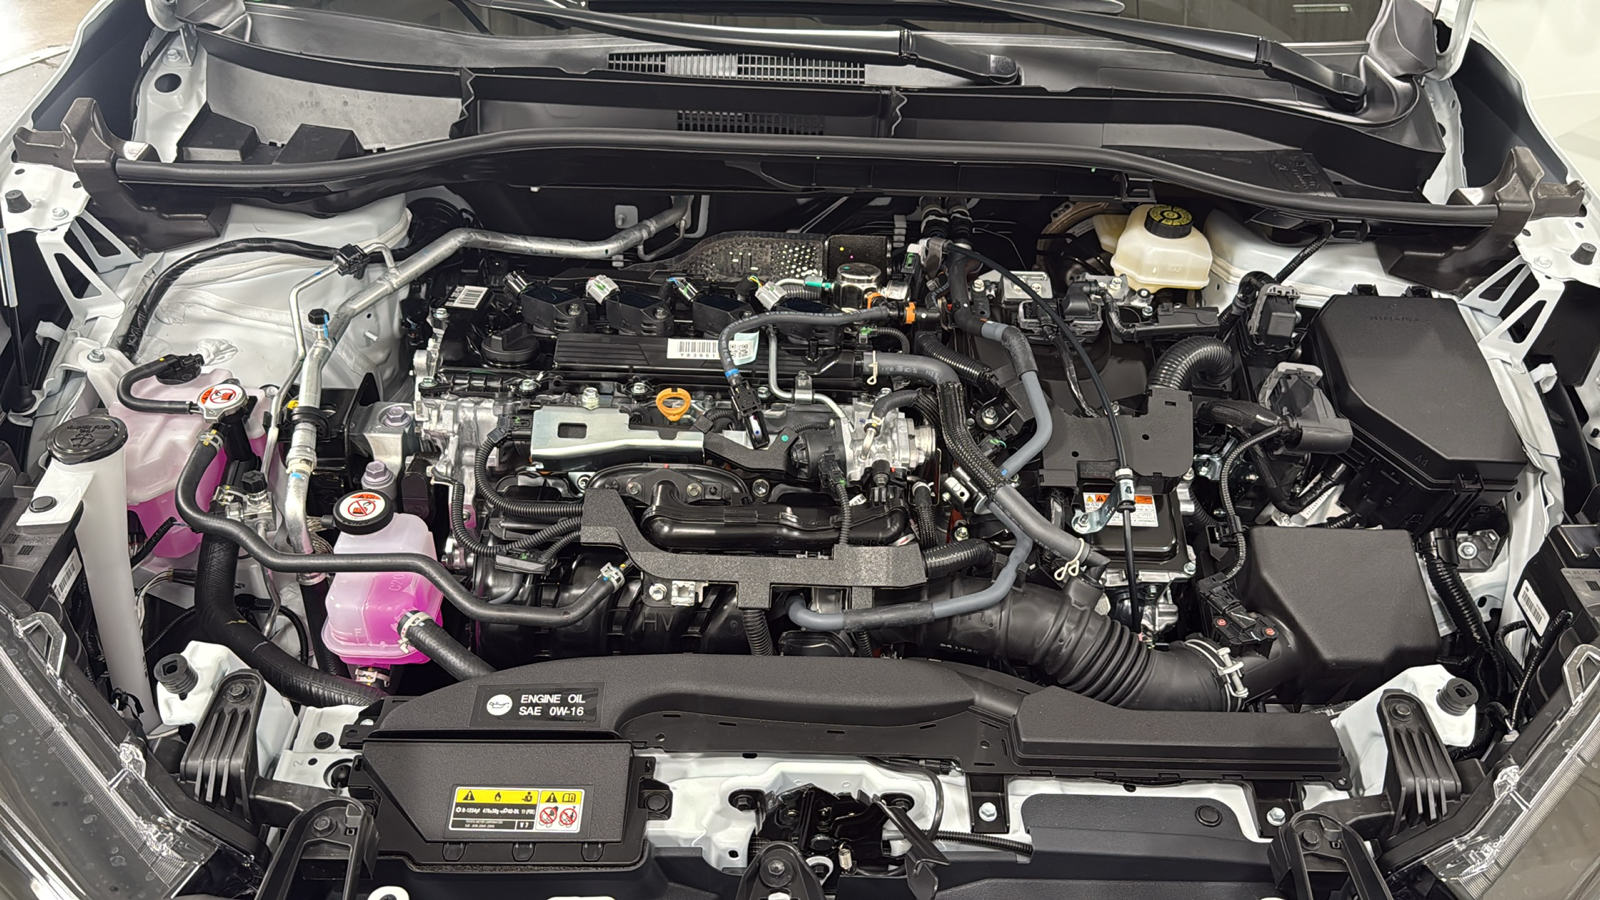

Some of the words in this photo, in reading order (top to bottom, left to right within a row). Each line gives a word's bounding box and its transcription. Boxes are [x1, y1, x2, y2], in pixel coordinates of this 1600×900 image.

[642, 611, 675, 631] HV
[520, 694, 561, 704] ENGINE
[567, 694, 586, 704] OIL
[518, 706, 542, 716] SAE
[549, 706, 585, 716] 0W-16
